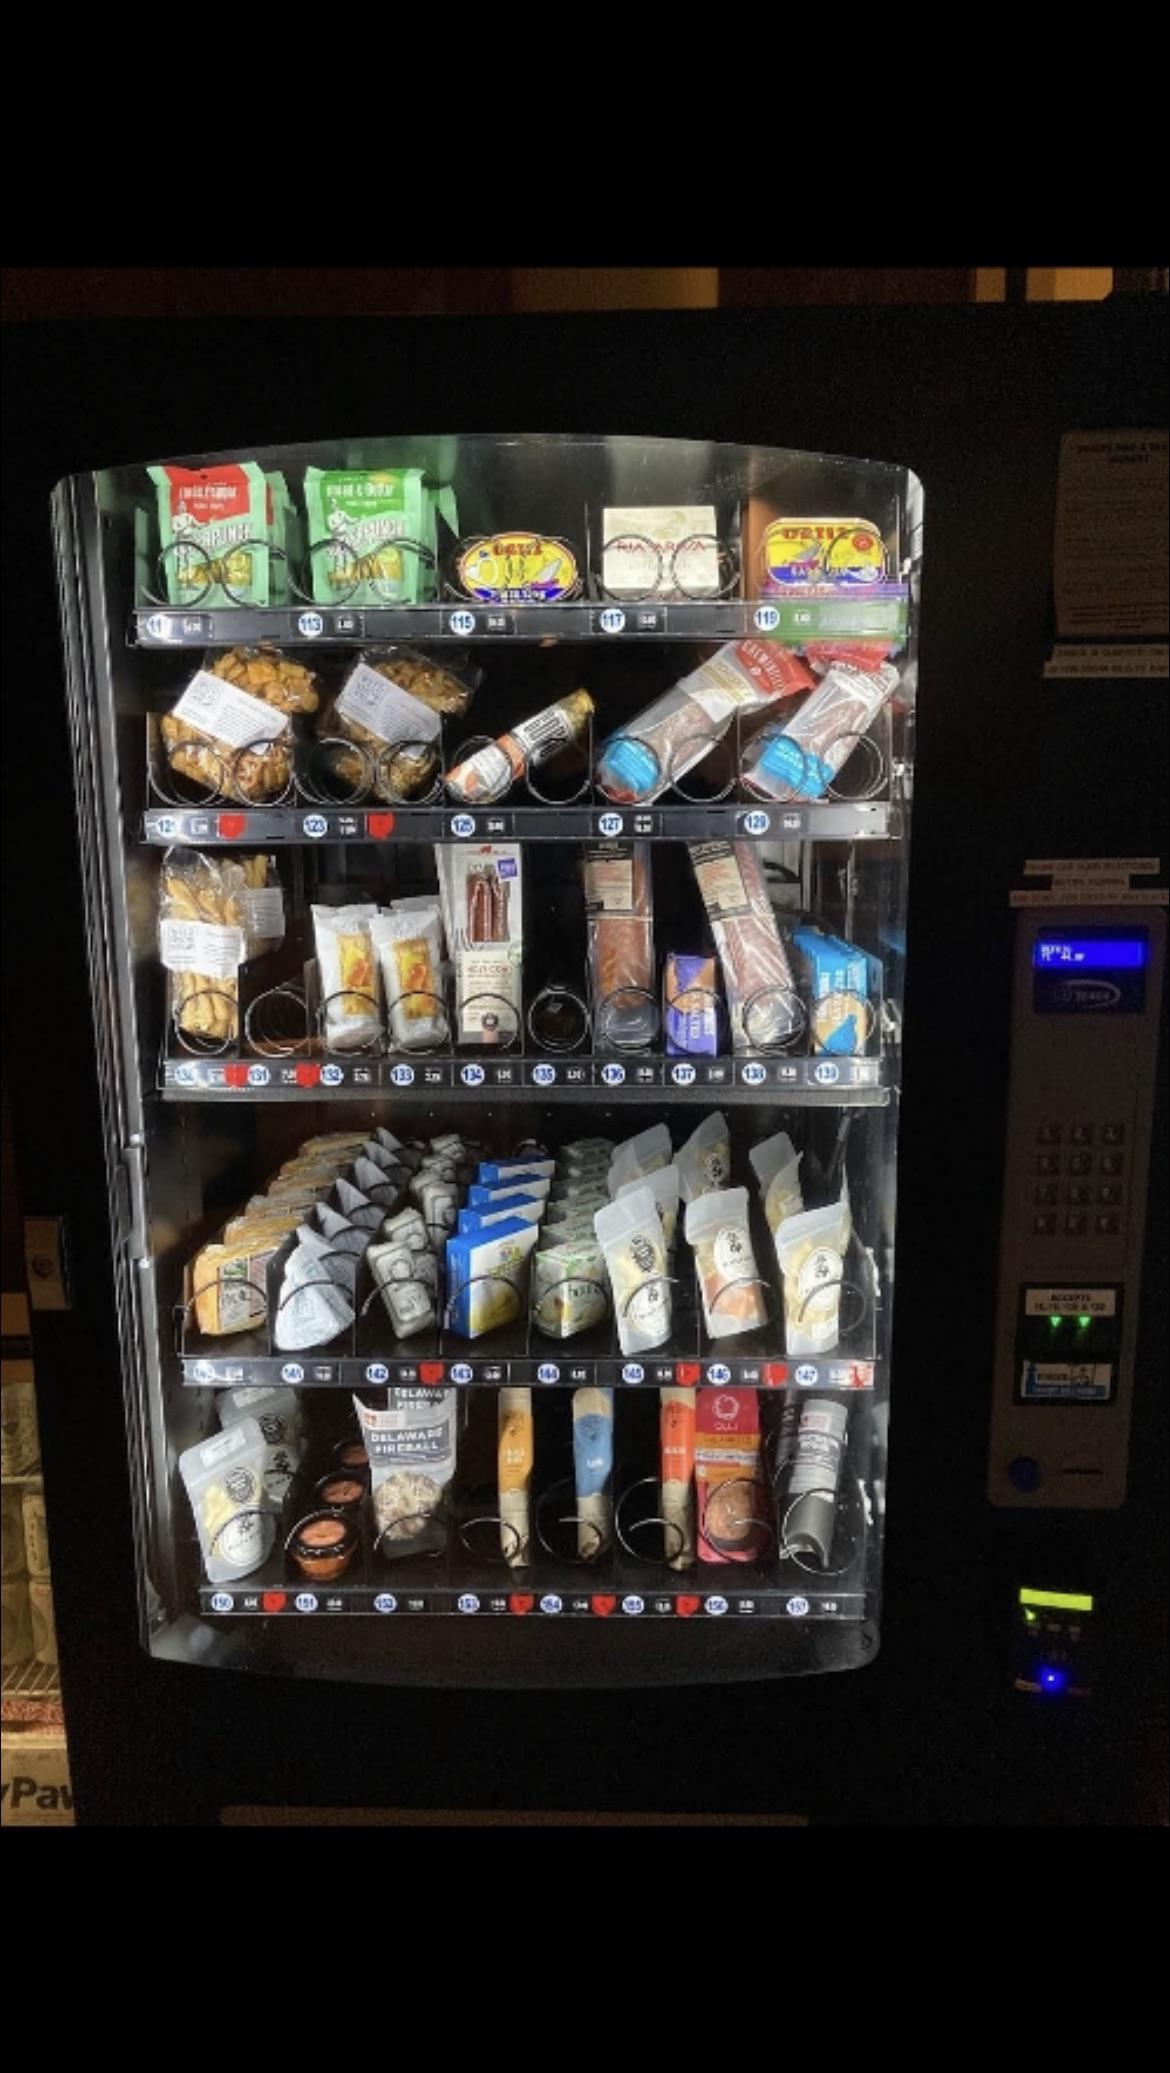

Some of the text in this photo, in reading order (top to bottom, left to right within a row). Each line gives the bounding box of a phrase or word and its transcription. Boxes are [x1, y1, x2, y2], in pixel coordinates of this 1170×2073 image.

[451, 616, 473, 630] 115
[601, 613, 623, 627] 117
[755, 611, 778, 625] 119
[600, 817, 622, 831] 127
[462, 1068, 483, 1081] 134
[673, 1067, 694, 1081] 137
[367, 1367, 387, 1379] 142
[371, 1427, 443, 1443] DELAWARE
[375, 1441, 439, 1454] FIREBALL
